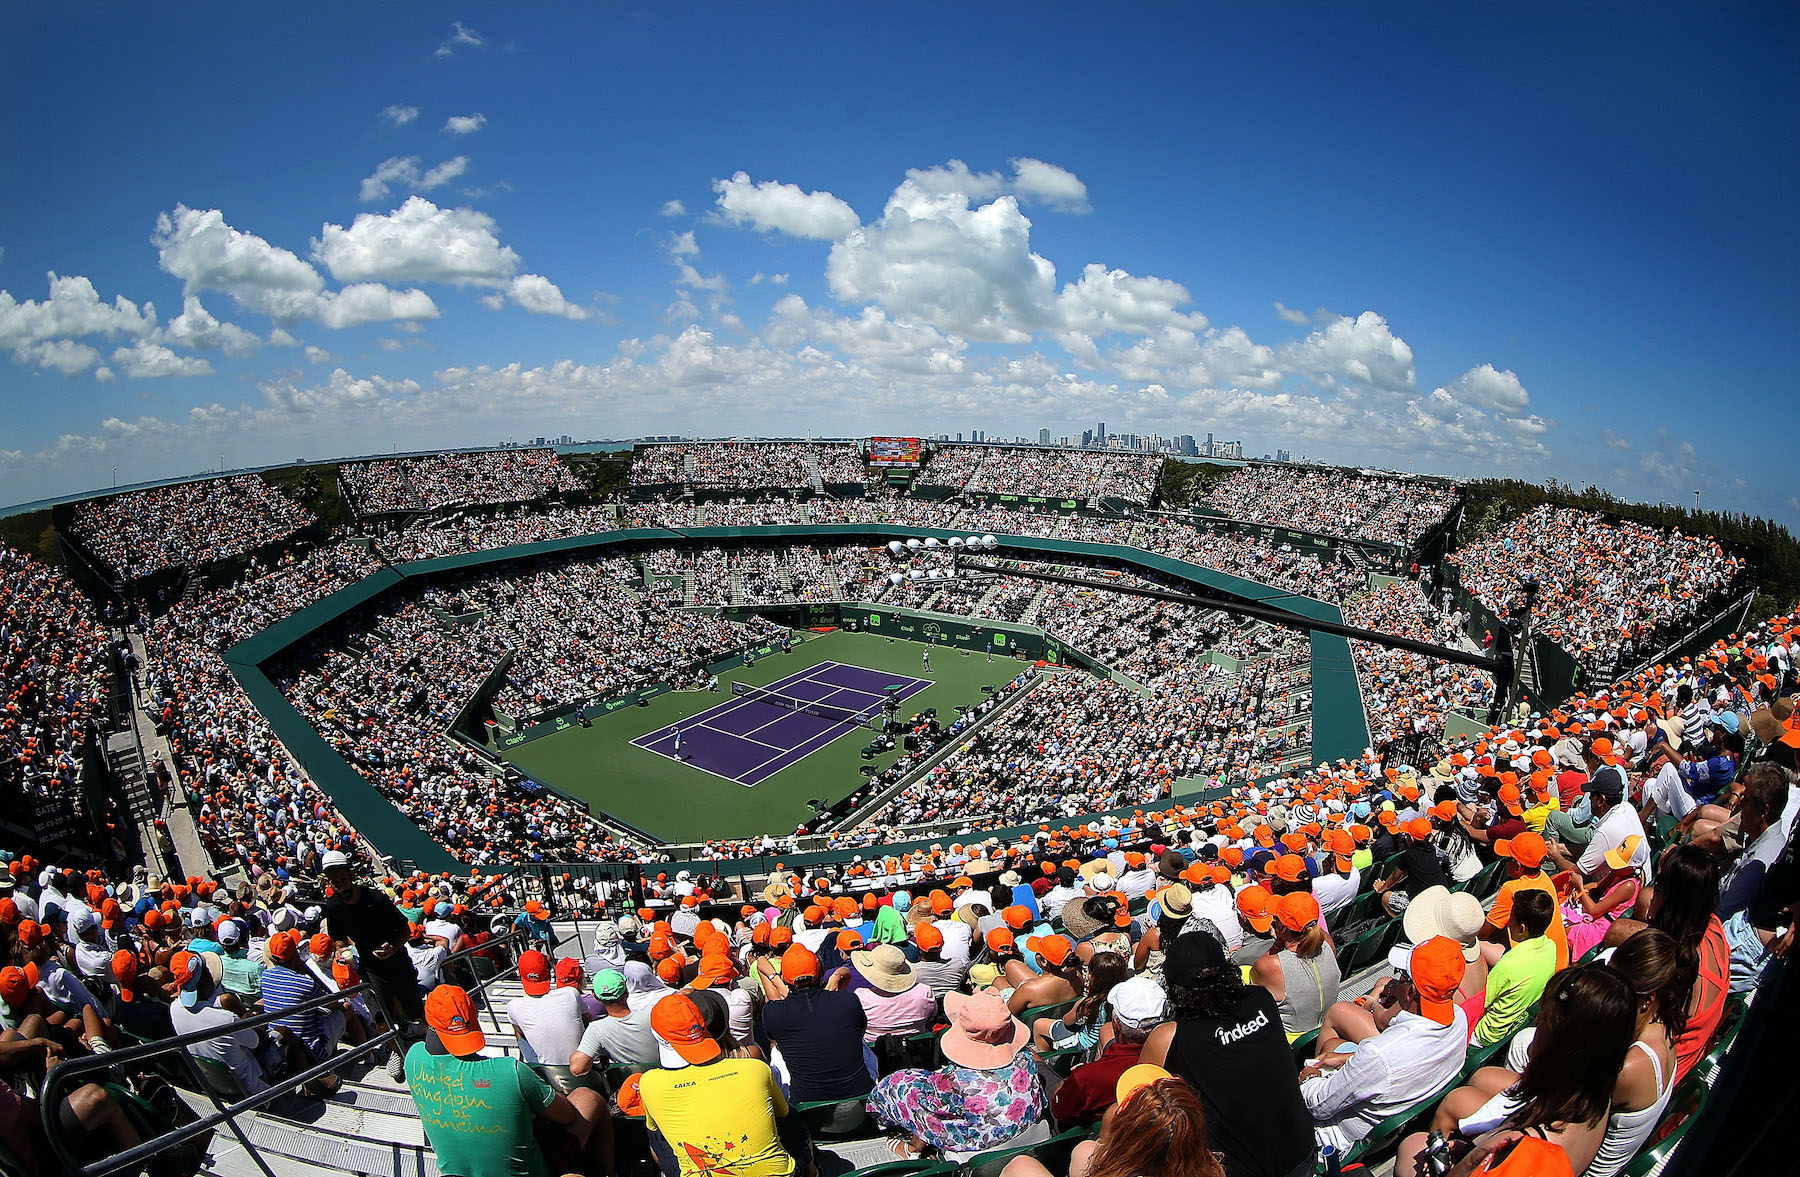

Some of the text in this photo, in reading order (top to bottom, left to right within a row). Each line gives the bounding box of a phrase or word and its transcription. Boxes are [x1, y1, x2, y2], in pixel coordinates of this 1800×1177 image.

[1571, 665, 1581, 688] E
[804, 708, 820, 717] TOUR
[505, 732, 526, 746] Claro
[35, 801, 61, 816] GATE F
[1216, 1010, 1270, 1045] indeed
[413, 1060, 464, 1091] United
[674, 1081, 697, 1089] CAIXA
[452, 1106, 471, 1121] of
